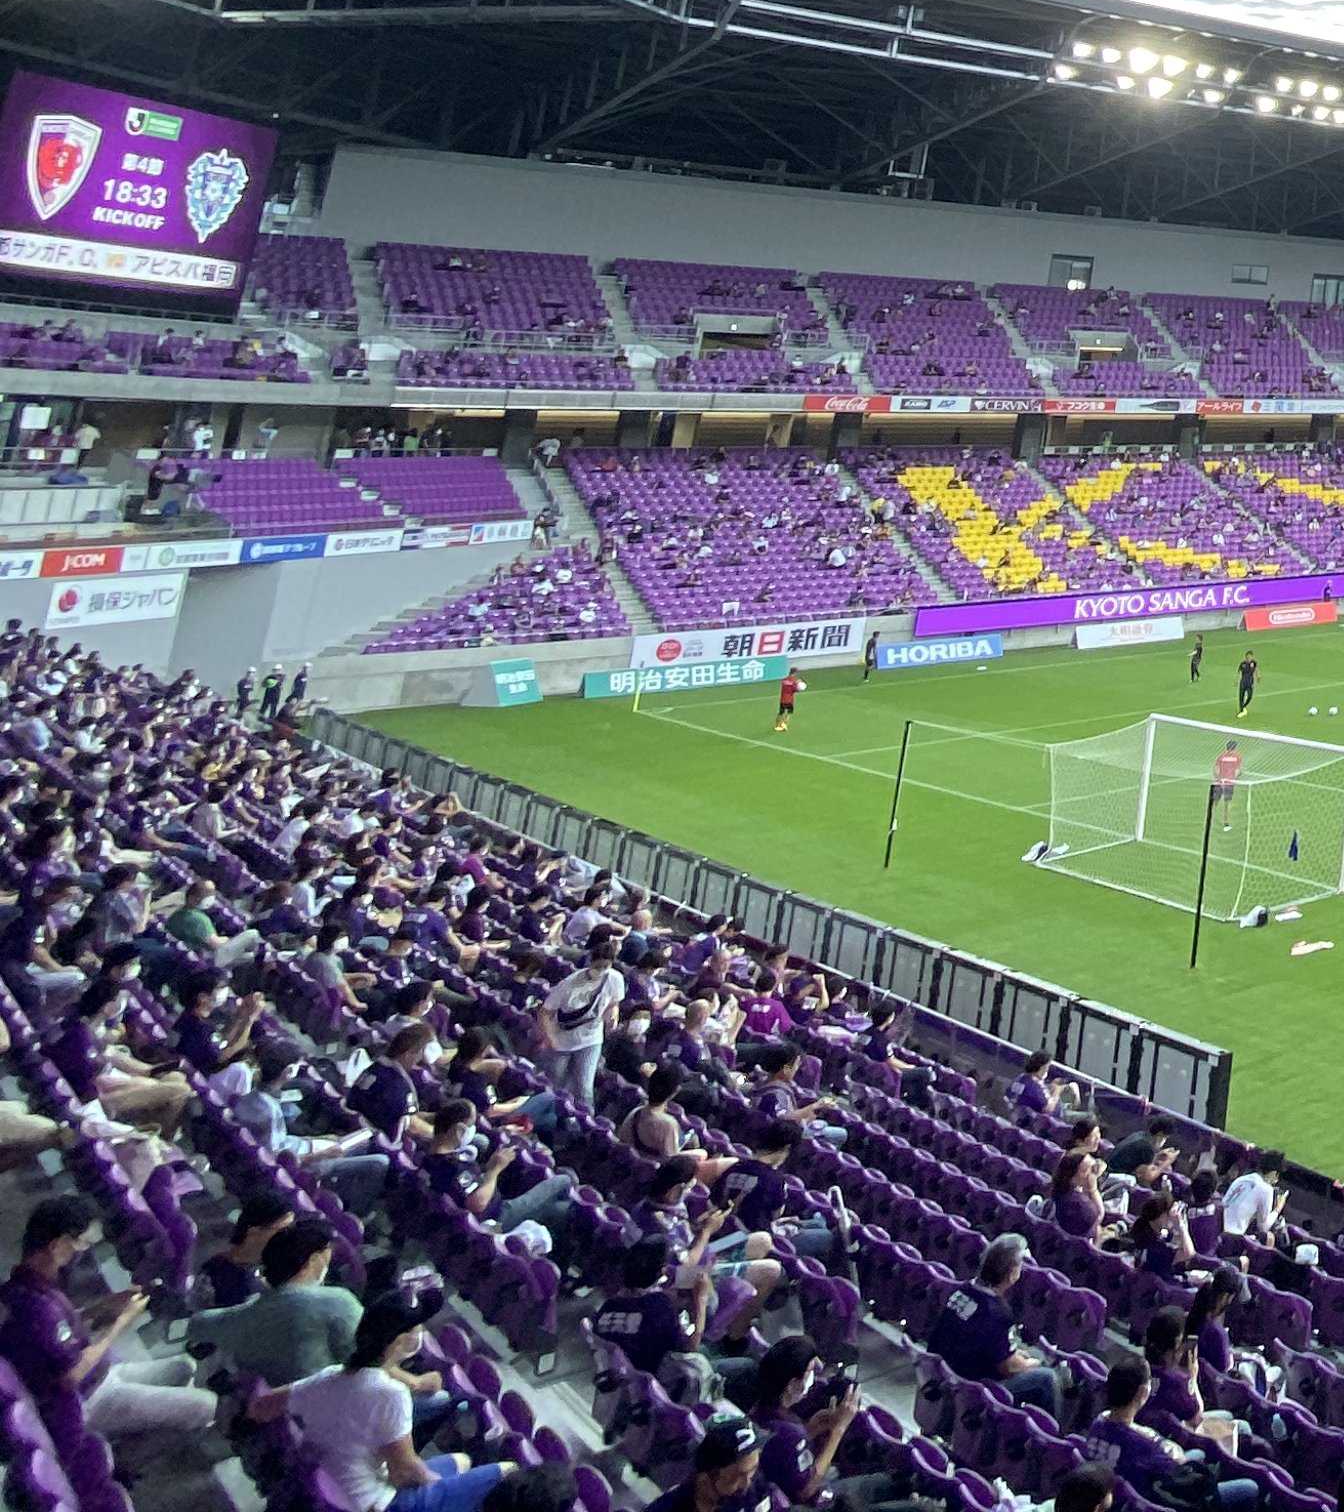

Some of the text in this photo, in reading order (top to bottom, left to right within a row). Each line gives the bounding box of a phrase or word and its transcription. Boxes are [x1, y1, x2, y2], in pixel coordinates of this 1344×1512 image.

[103, 178, 168, 209] 18:33
[985, 399, 1031, 411] CERVIN
[1074, 585, 1250, 620] KYOTO SANGA F.C.
[722, 624, 852, 658] 朝日新聞
[886, 638, 994, 665] HORIBA
[609, 659, 766, 694] 明治安田生命
